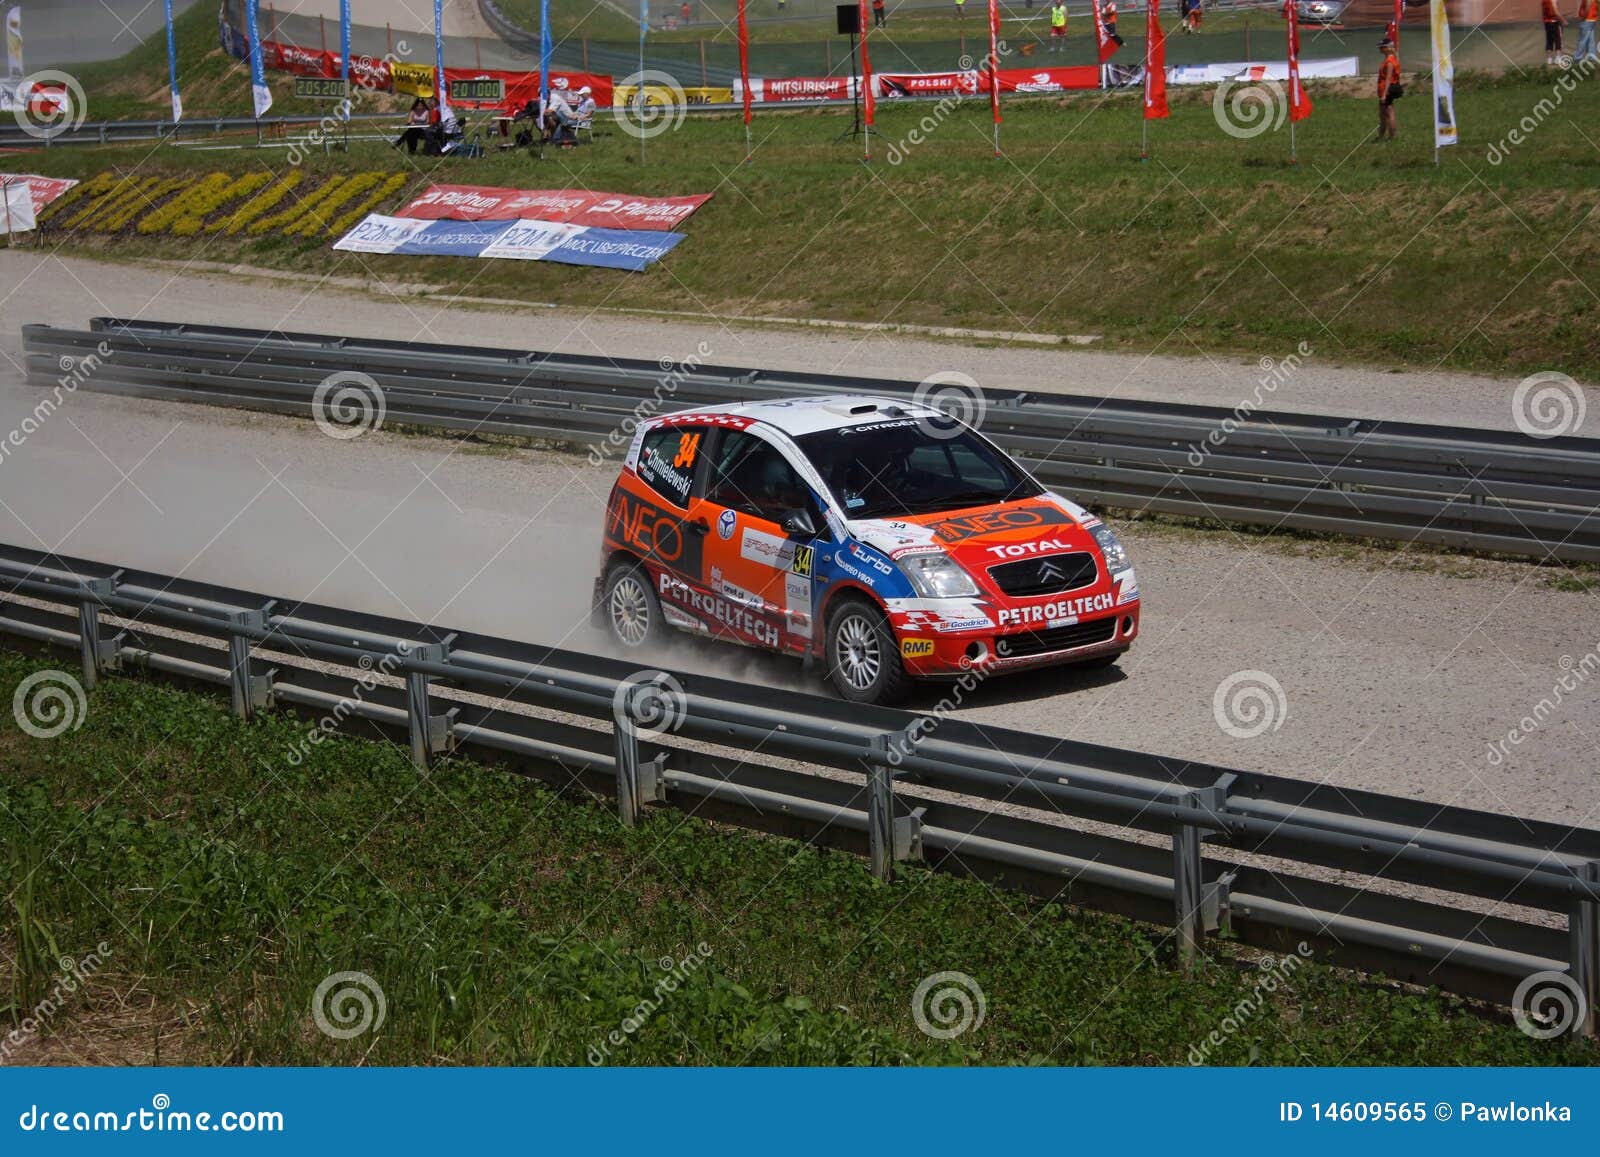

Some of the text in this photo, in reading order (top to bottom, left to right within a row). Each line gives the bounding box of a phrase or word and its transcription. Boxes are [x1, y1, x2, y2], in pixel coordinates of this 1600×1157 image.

[771, 80, 840, 94] MITSUBISHI
[911, 79, 952, 88] POLSKI
[673, 432, 701, 468] 34
[647, 448, 693, 497] Chmielewski
[610, 495, 684, 562] NEO
[939, 511, 1043, 540] NEO
[794, 546, 811, 575] 34
[987, 539, 1072, 558] TOTAL
[857, 571, 875, 587] VBOX
[660, 573, 779, 647] PETROELTECH
[998, 592, 1114, 625] PETROELTECH
[903, 642, 932, 654] RMF
